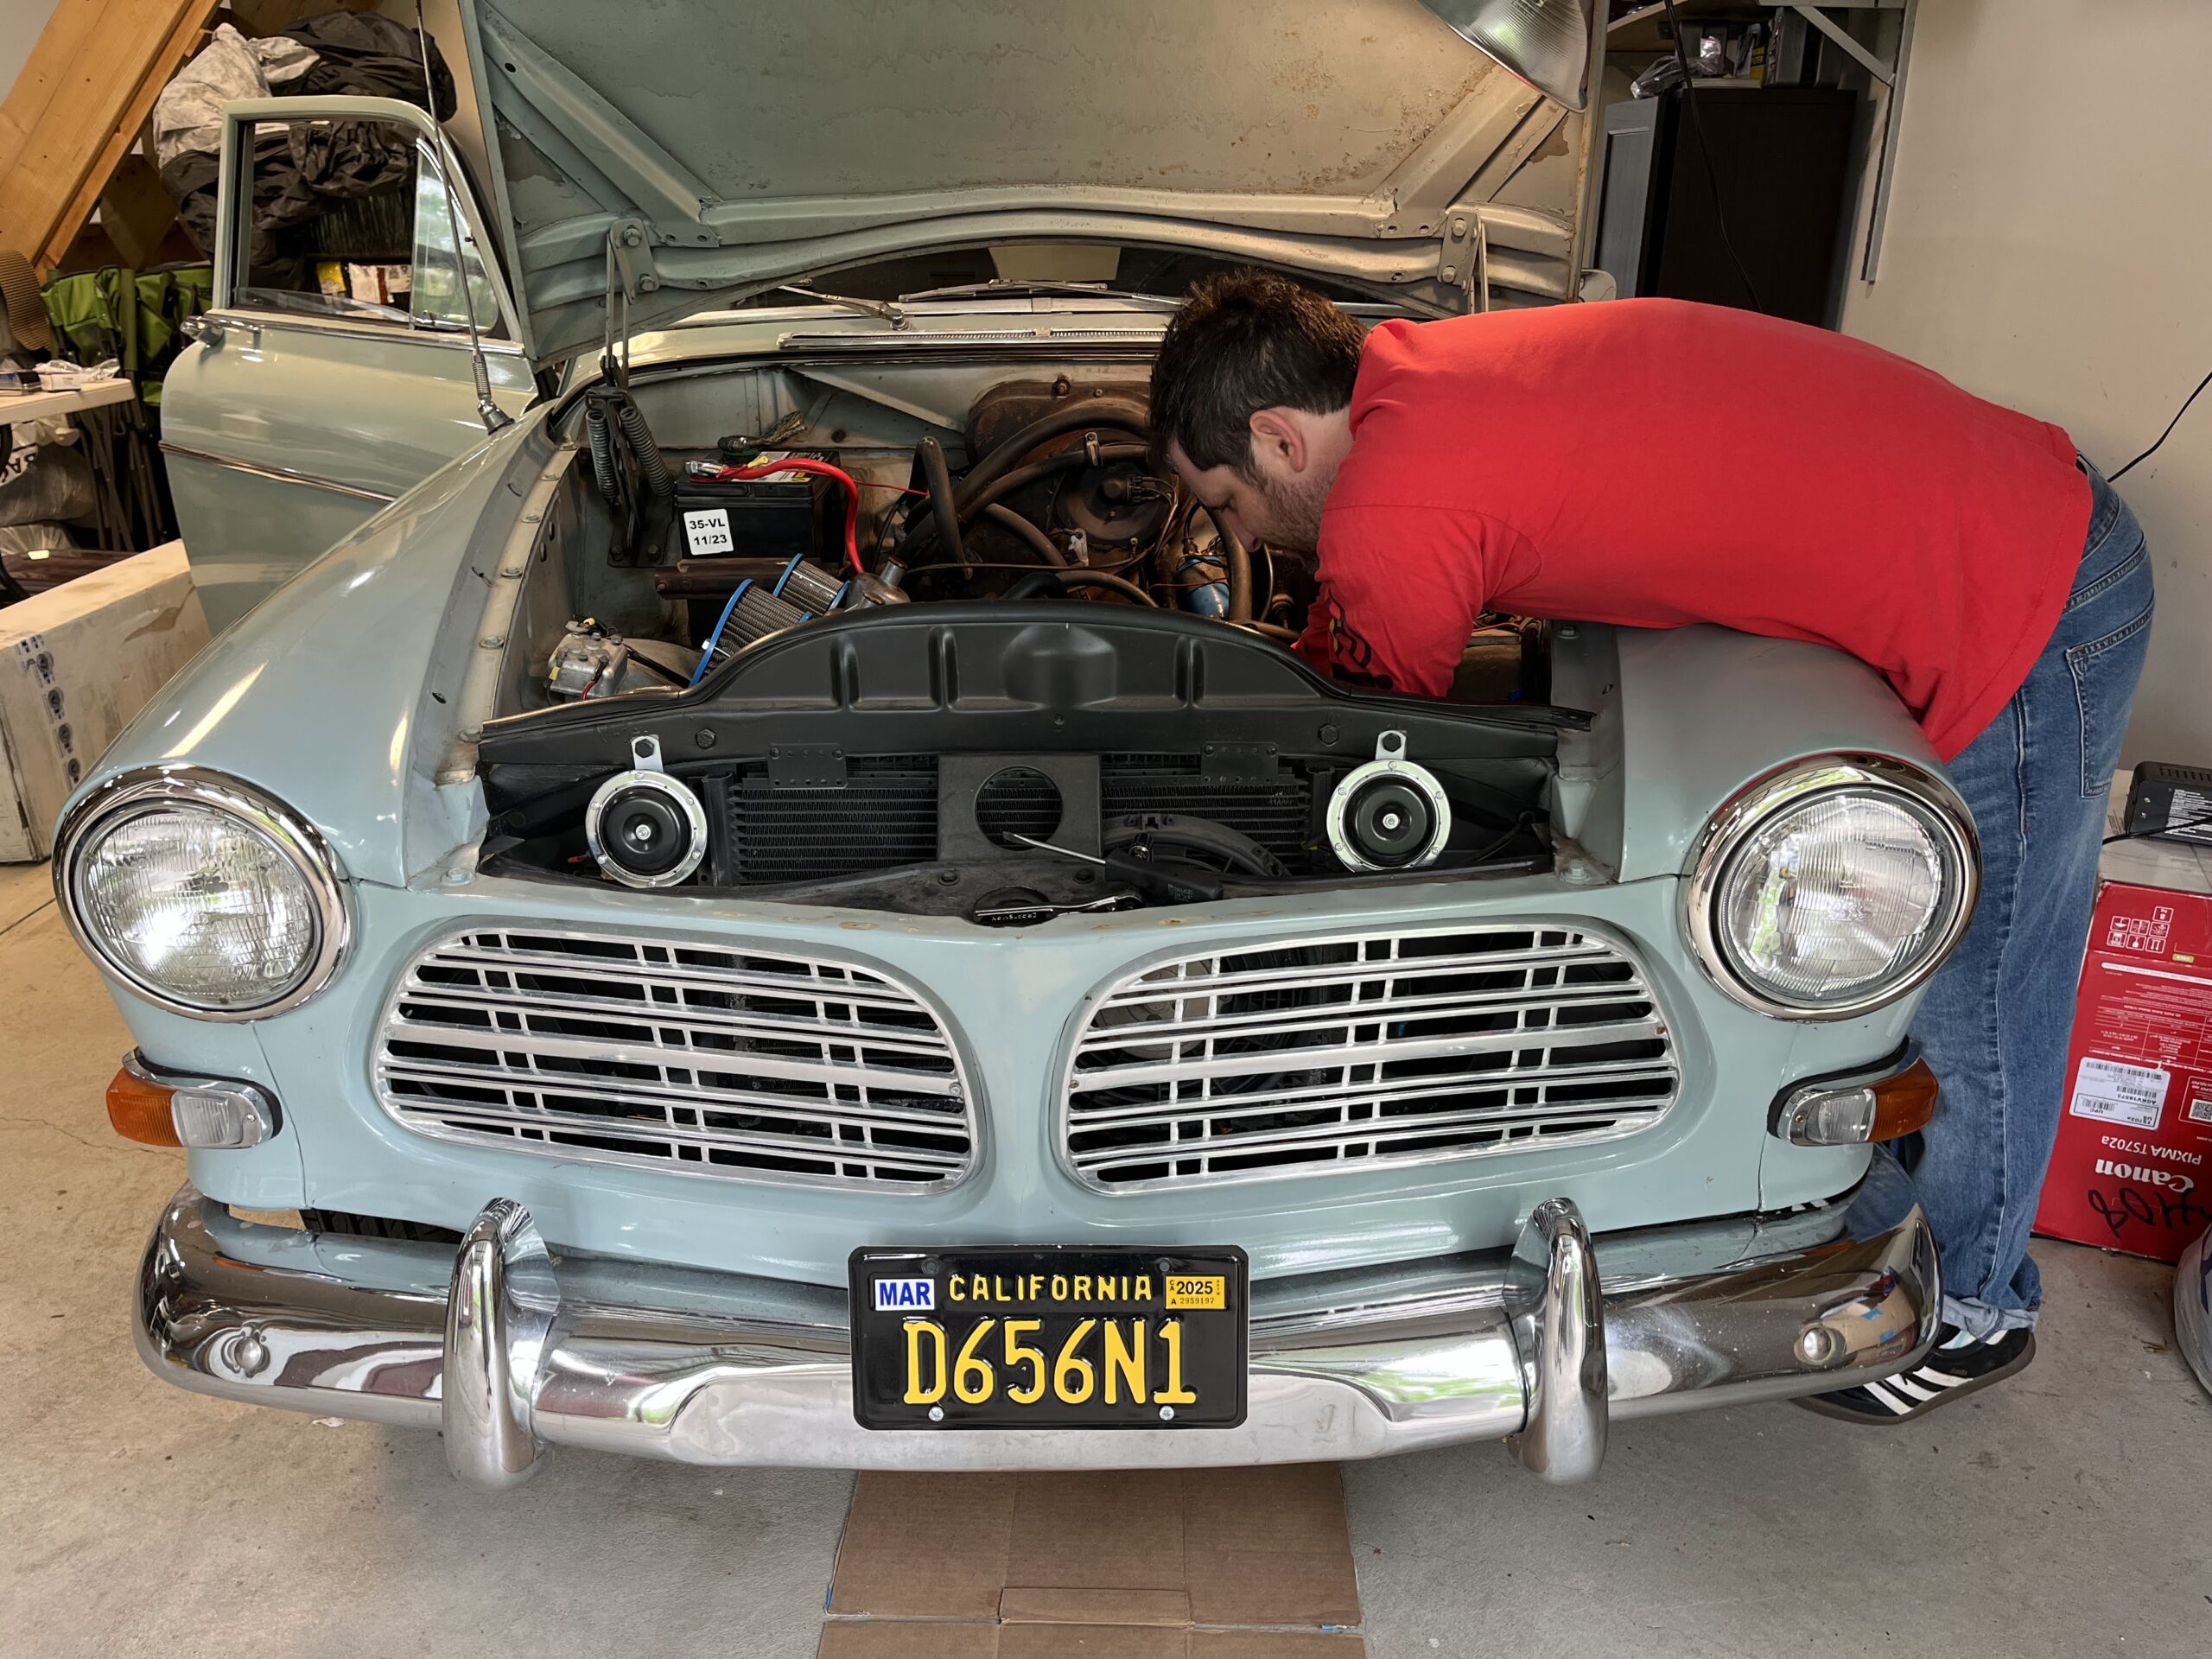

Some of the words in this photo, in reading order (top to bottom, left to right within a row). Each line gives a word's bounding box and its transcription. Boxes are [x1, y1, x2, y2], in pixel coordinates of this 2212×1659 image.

[689, 518, 726, 530] 35-VL
[693, 534, 728, 546] 11/23
[2101, 1135, 2148, 1155] TS702a
[2150, 1145, 2202, 1166] PIXMA
[2094, 1159, 2195, 1193] Canon
[880, 1281, 931, 1306] MAR
[949, 1274, 1152, 1301] CALIFORNIA
[1176, 1281, 1213, 1295] 2025
[902, 1319, 1197, 1405] D656N1
